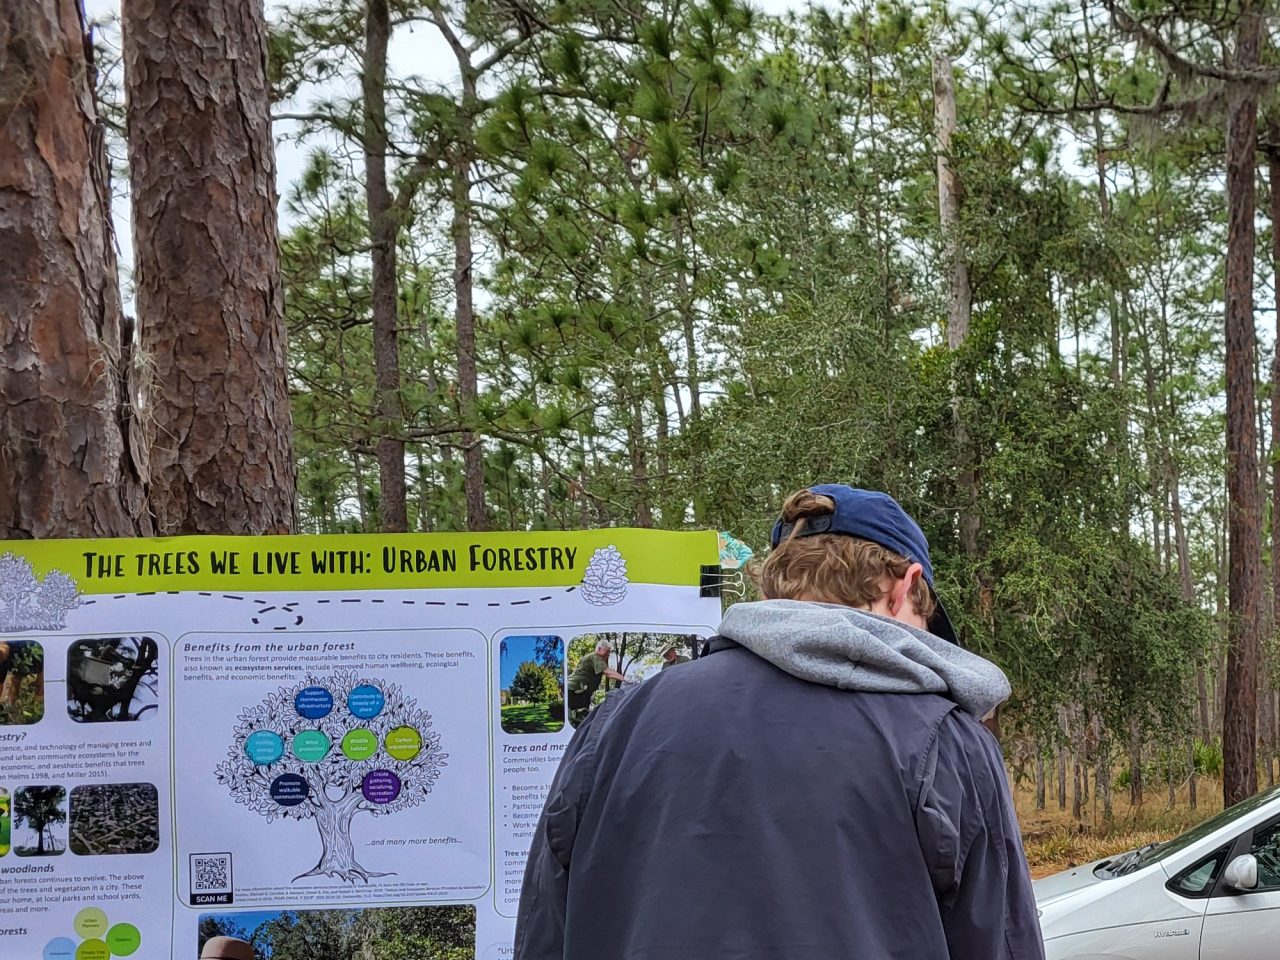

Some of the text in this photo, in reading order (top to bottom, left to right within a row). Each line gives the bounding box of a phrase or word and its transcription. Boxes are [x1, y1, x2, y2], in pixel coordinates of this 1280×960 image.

[83, 544, 577, 579] THE TREES WE LIVE WITH: URBAN FORESTRY
[183, 641, 355, 653] Benefits from the urban forest
[183, 654, 202, 662] Trees
[212, 654, 225, 662] the
[226, 654, 247, 662] urban
[248, 654, 269, 662] forest
[270, 654, 297, 664] provide
[340, 652, 367, 661] benefits
[424, 651, 445, 659] These
[234, 664, 272, 673] ecosystem
[364, 661, 389, 670] human
[215, 673, 229, 681] and
[230, 673, 264, 681] economic
[503, 743, 527, 753] Trees
[529, 743, 548, 752] and
[1, 863, 55, 874] woodlands
[195, 894, 228, 903] SCAN ME
